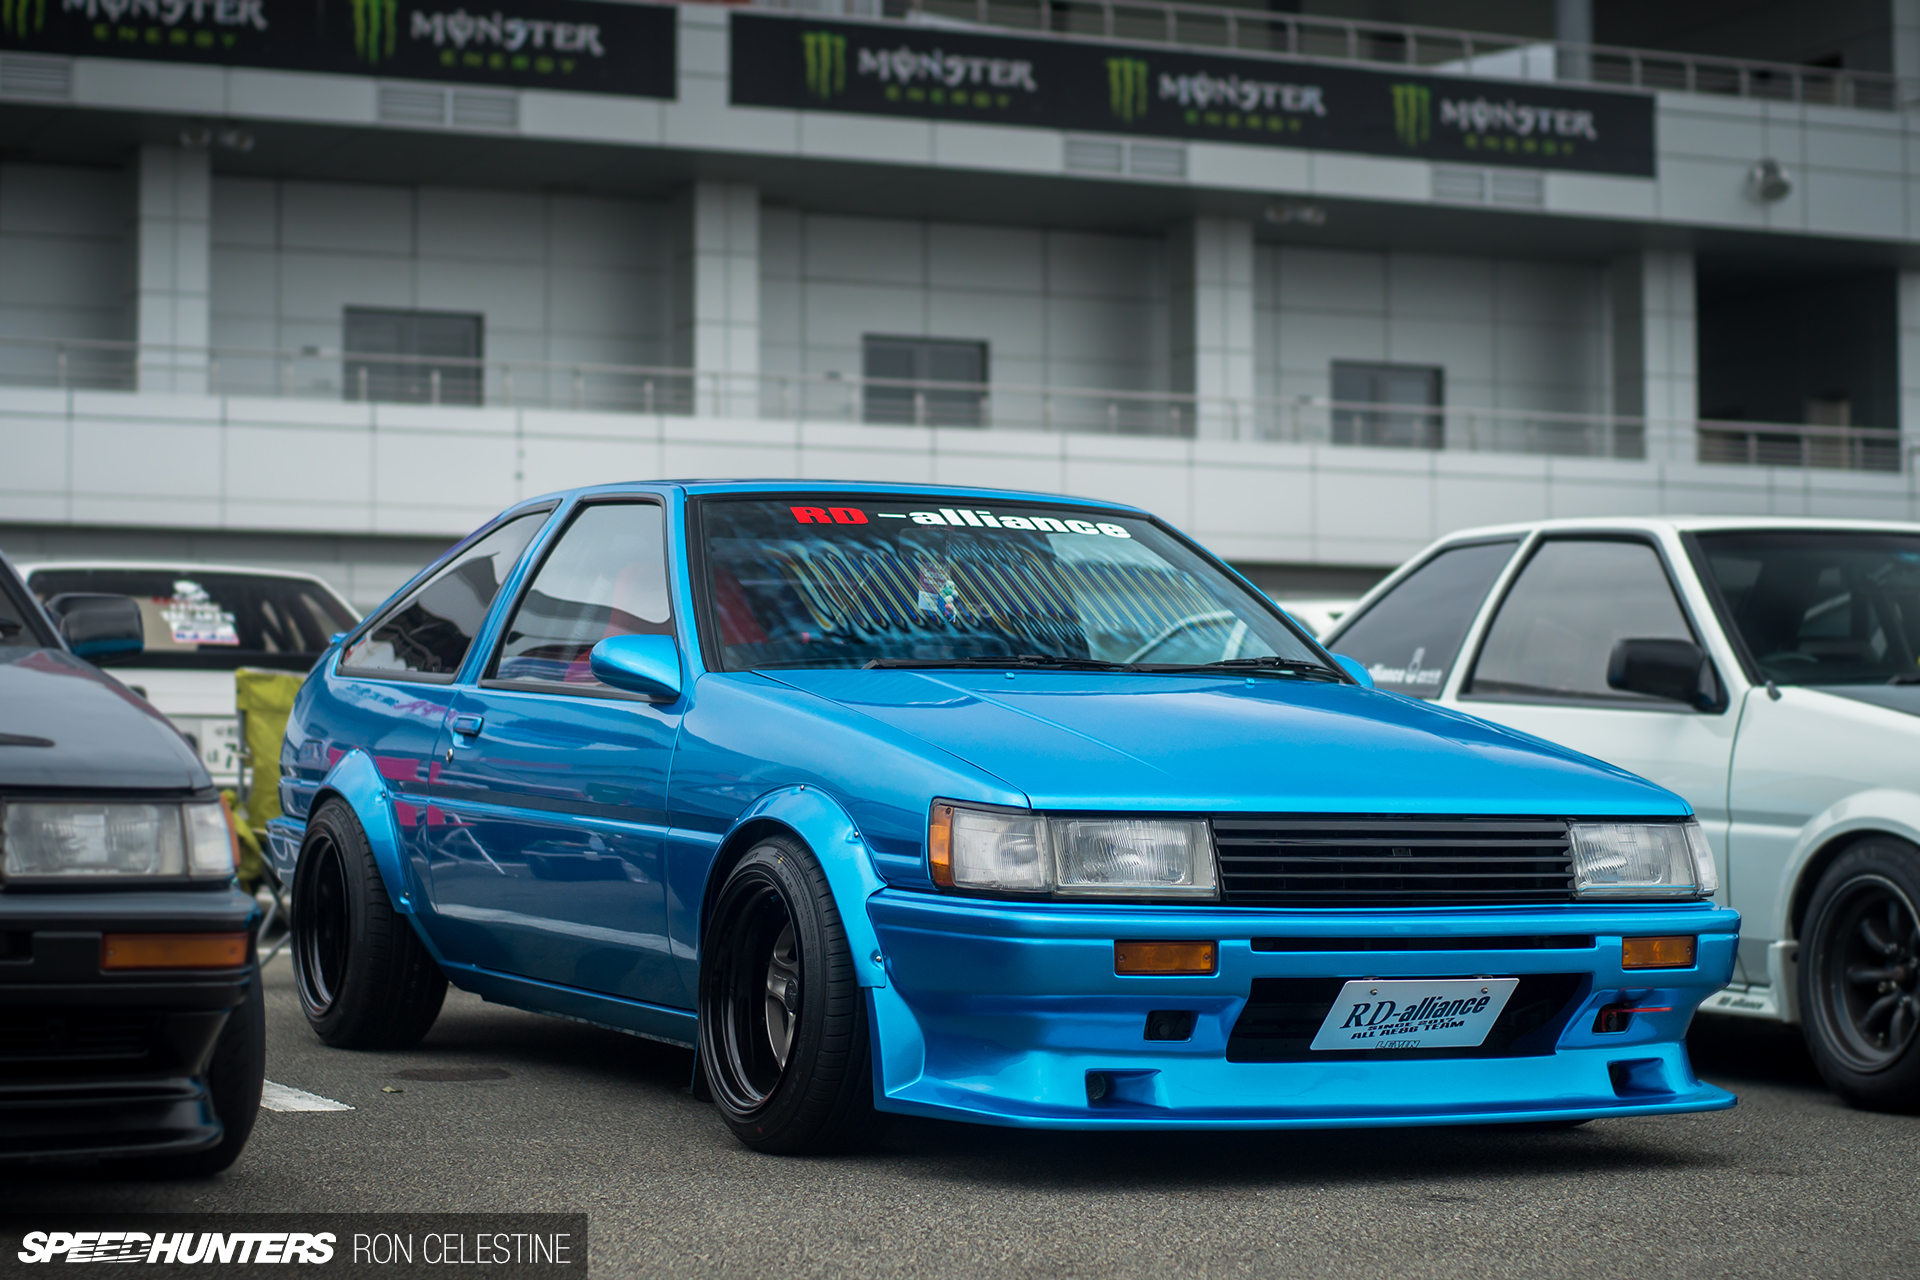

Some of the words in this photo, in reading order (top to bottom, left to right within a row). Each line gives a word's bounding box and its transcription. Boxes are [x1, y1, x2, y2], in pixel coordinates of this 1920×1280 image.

[410, 8, 605, 57] MONSTER
[858, 46, 1038, 92] MONSTER
[1158, 71, 1327, 117] MONSTER
[1440, 96, 1598, 141] MONSTER
[790, 506, 869, 525] RD
[1339, 995, 1491, 1029] RD-alliance
[1367, 1021, 1413, 1031] SINCE
[1417, 1017, 1456, 1026] 2017
[1350, 1031, 1376, 1040] ALL
[1379, 1025, 1419, 1036] AE86
[1424, 1020, 1466, 1031] TEAM
[1375, 1040, 1421, 1049] LEVIN
